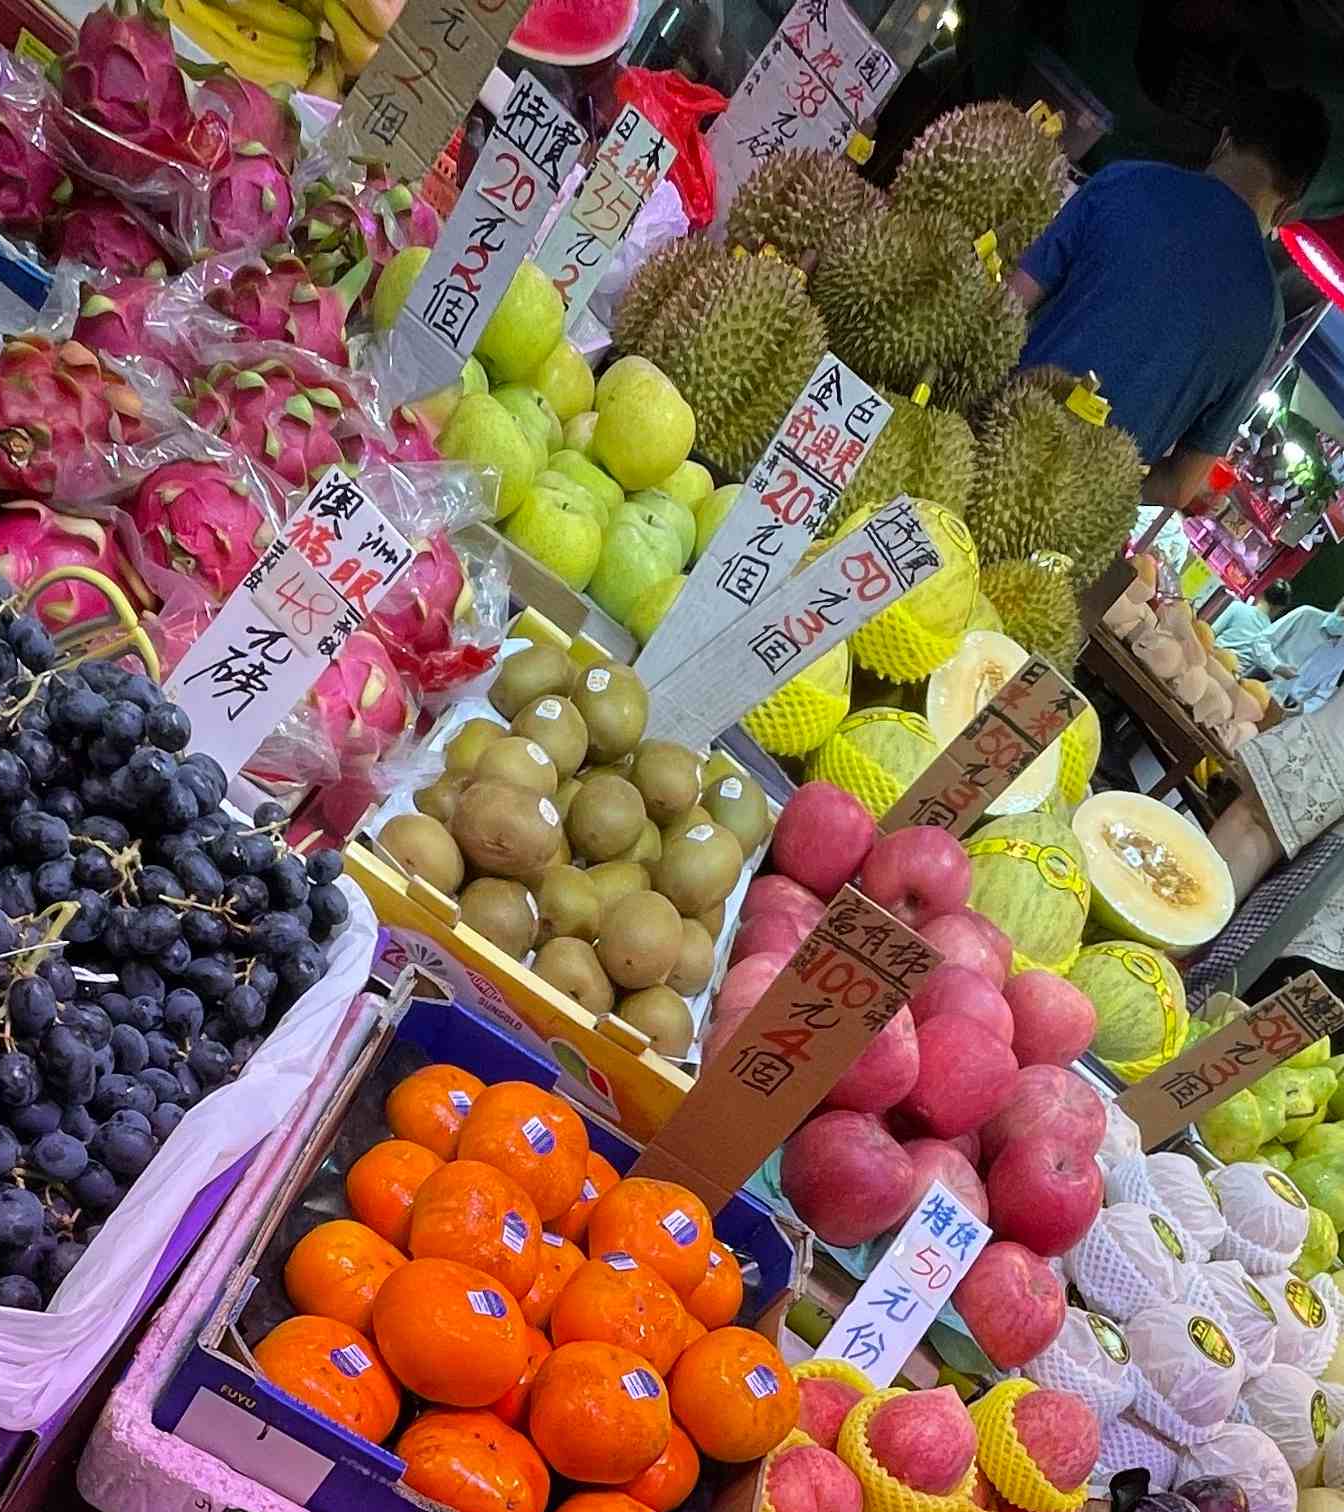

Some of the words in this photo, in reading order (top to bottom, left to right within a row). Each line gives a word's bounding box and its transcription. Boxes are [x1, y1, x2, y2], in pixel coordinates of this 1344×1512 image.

[429, 7, 468, 51] 元
[786, 69, 827, 118] 38
[363, 89, 408, 144] 個
[501, 82, 587, 188] 特價
[771, 106, 799, 140] 元
[615, 109, 671, 172] 日本
[481, 151, 536, 212] 20
[589, 174, 632, 234] 35
[474, 215, 505, 253] 元
[567, 232, 601, 267] 元
[450, 247, 491, 292] 2
[553, 264, 580, 302] 2
[424, 279, 476, 348] 個
[809, 363, 879, 443] 金色
[787, 405, 867, 490] 奇異果
[761, 469, 814, 526] 20
[307, 473, 412, 586] 澳洲
[751, 518, 784, 555] 元
[877, 501, 942, 586] 特價
[716, 552, 770, 605] 個
[840, 551, 891, 601] 50
[275, 572, 339, 636] 48
[809, 588, 849, 627] 元
[246, 626, 292, 664] 元
[748, 623, 802, 675] 個
[784, 608, 824, 648] 3
[184, 646, 272, 721] 磅
[961, 760, 994, 788] 元
[799, 949, 879, 1010] 100
[479, 996, 524, 1031] SUNGOLD
[787, 998, 841, 1032] 元
[1255, 1012, 1304, 1056] 50
[761, 1026, 813, 1063] 4
[1222, 1041, 1259, 1072] 元
[730, 1046, 796, 1097] 個
[1161, 1071, 1213, 1109] 個
[1199, 1057, 1236, 1088] 3
[910, 1247, 953, 1291] 50
[868, 1286, 920, 1324] 元
[840, 1323, 888, 1369] 份
[219, 1383, 257, 1410] FUYU
